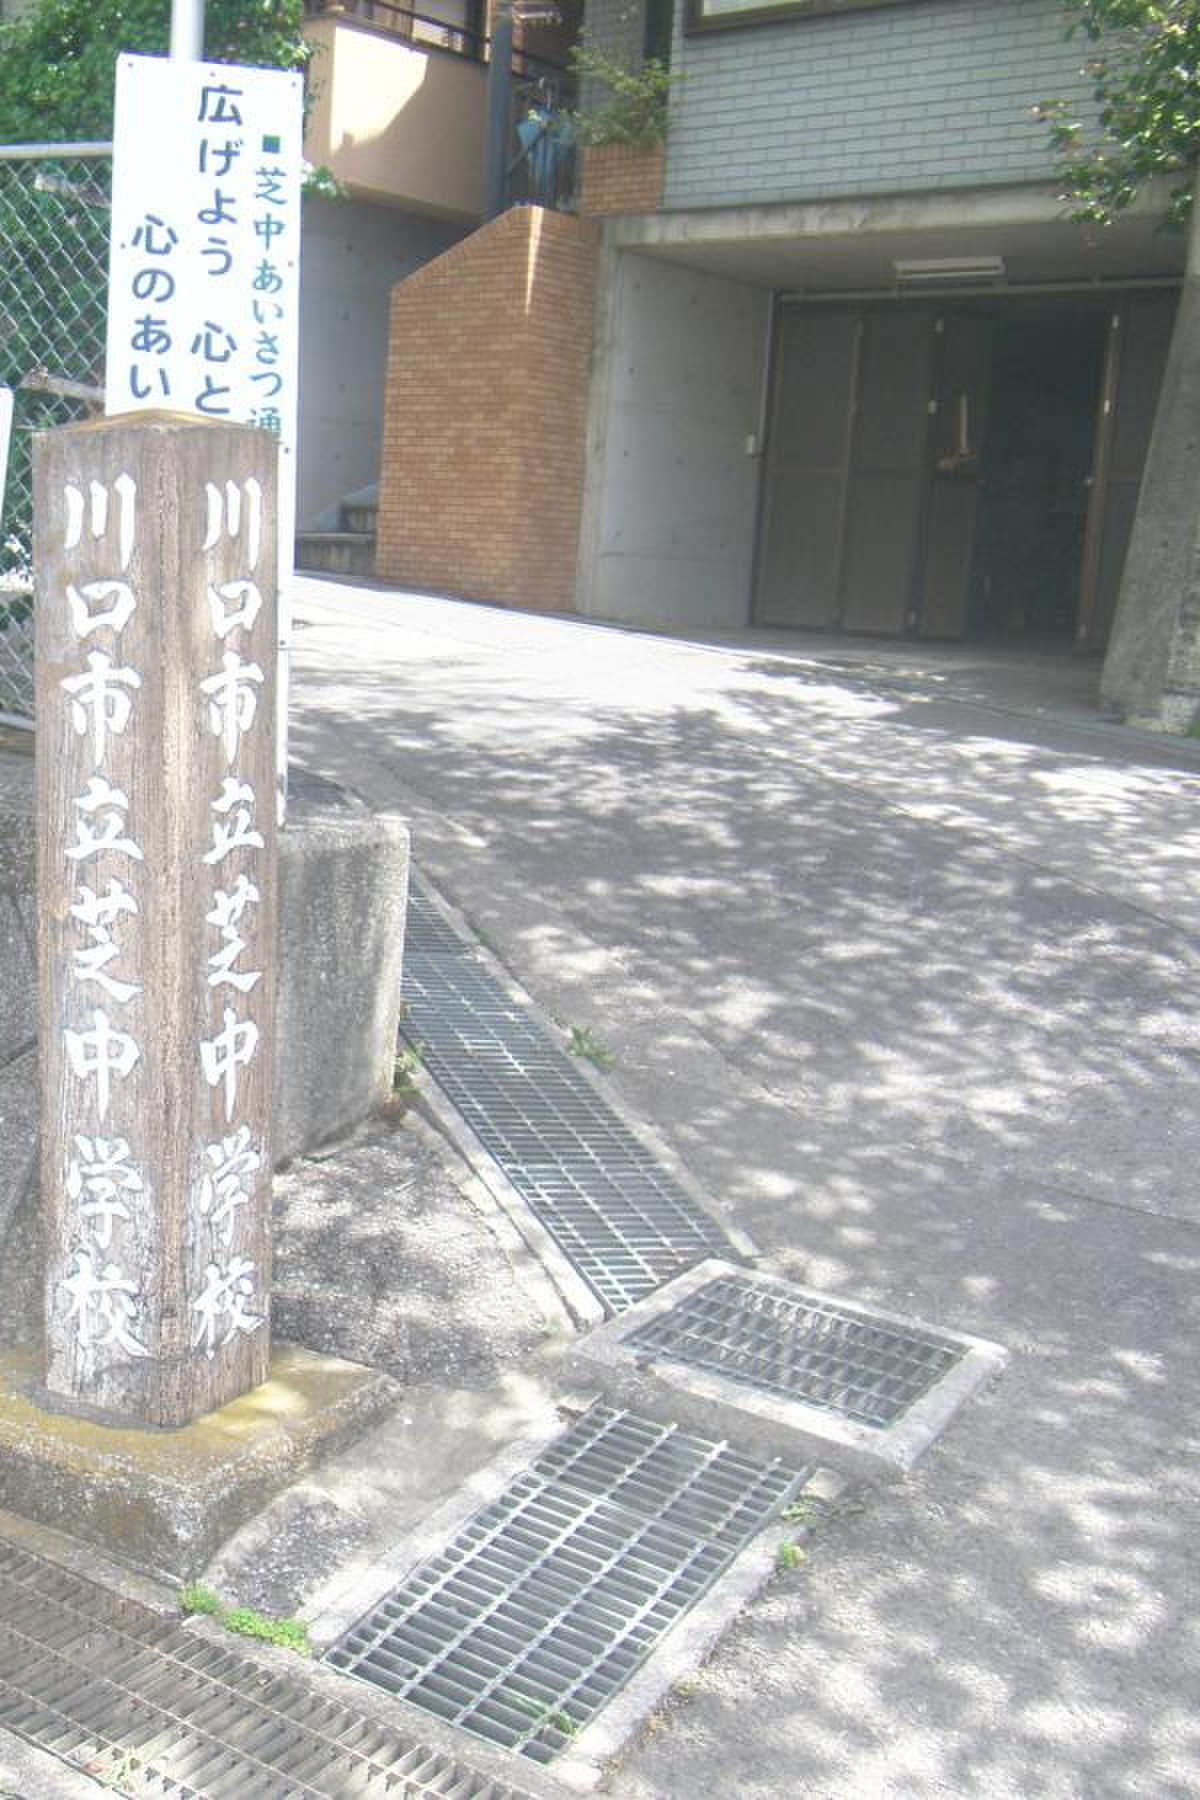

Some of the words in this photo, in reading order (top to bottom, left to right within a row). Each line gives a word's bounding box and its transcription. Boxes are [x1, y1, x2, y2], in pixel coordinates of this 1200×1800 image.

[197, 84, 245, 277] 広げよう
[129, 214, 179, 400] 心のあい
[191, 321, 238, 415] 心と
[60, 473, 150, 1359] 川口市立芝中学校
[194, 476, 266, 1360] 川口市立芝中学校
